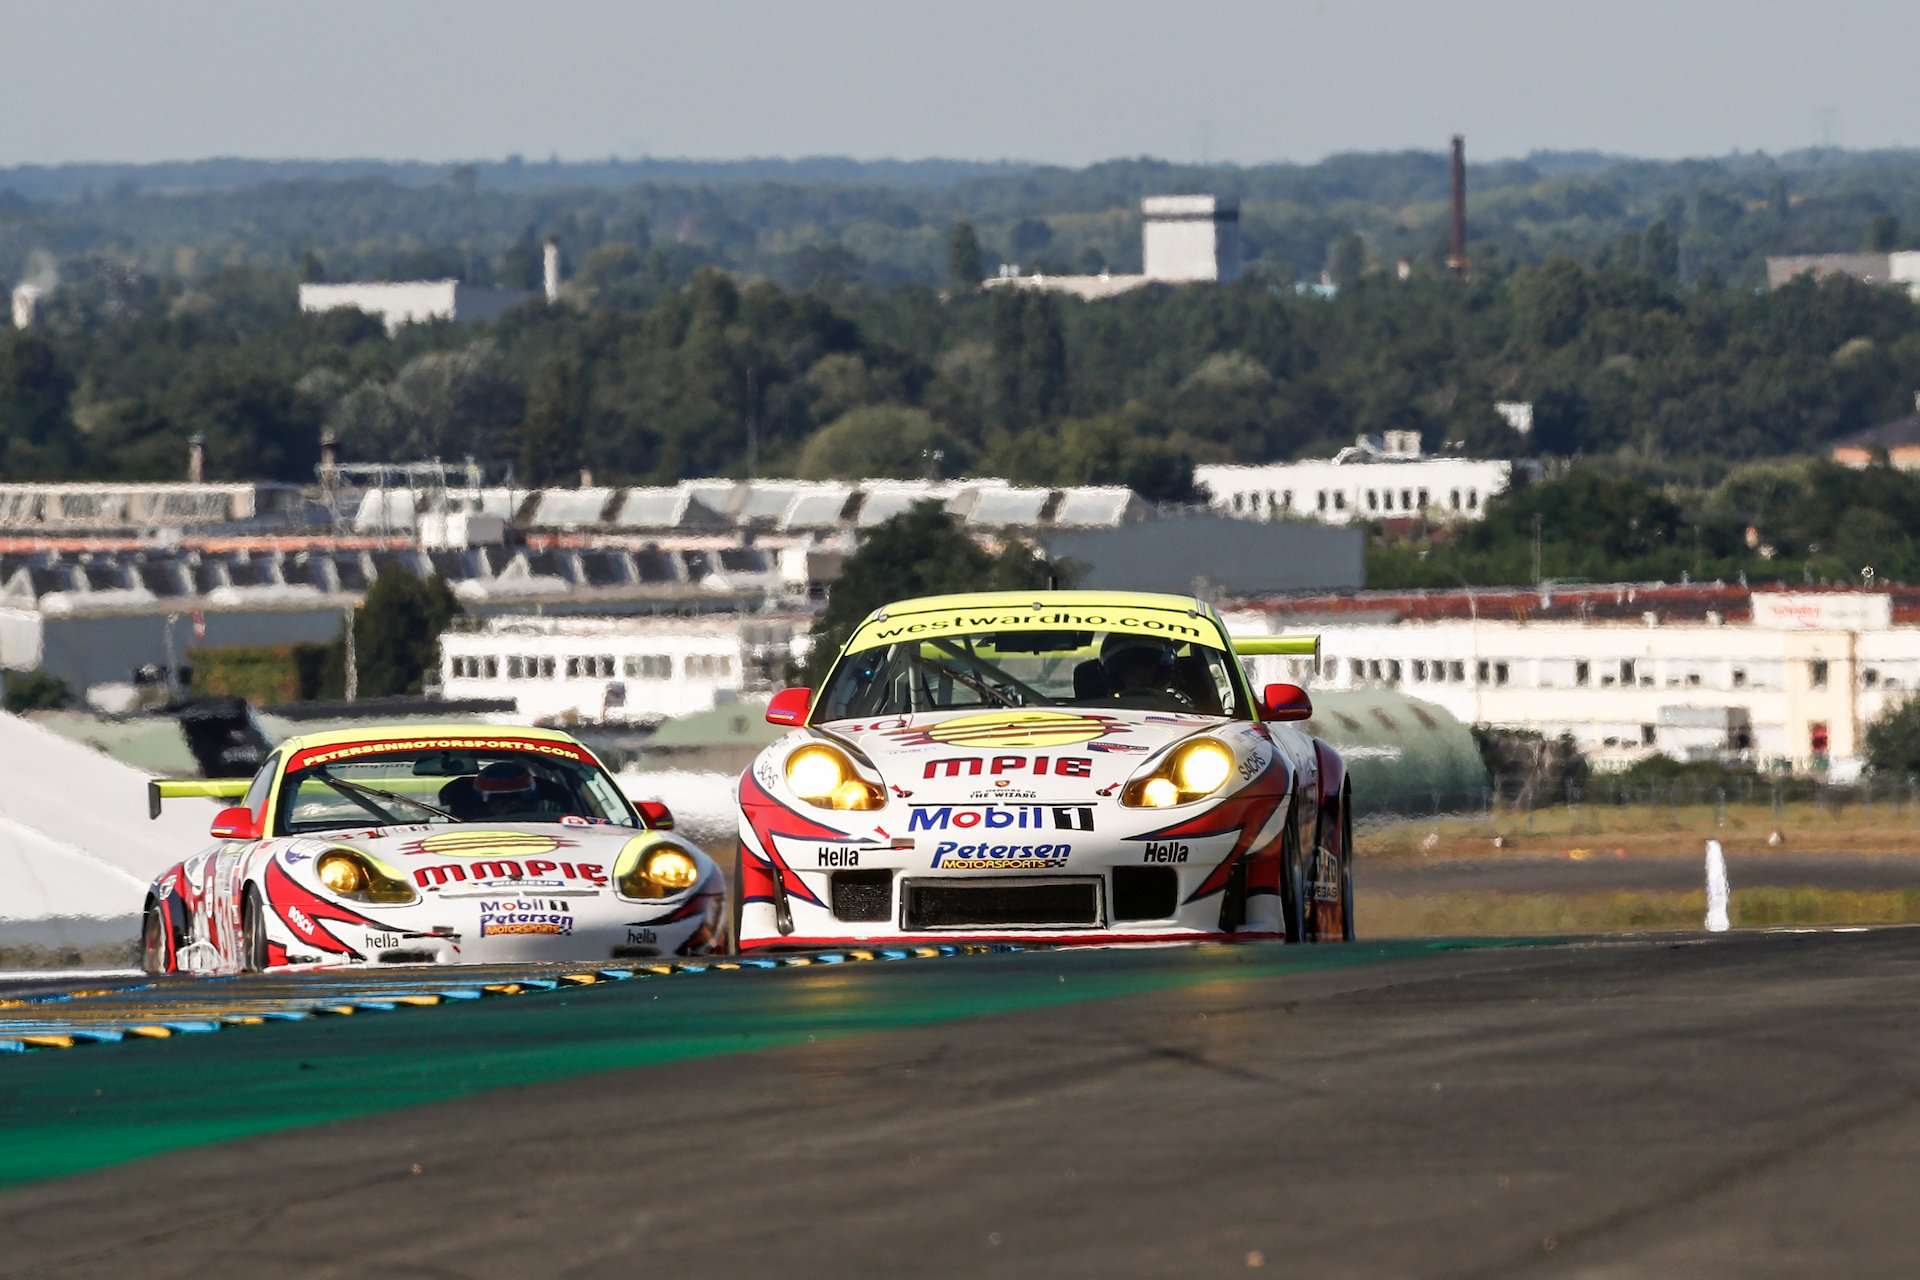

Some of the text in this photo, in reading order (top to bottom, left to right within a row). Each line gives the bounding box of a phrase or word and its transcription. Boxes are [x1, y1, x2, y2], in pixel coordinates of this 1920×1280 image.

[876, 613, 1201, 639] westwardho.com
[304, 740, 580, 767] PETERSENMOTORSPORTS.COM
[1238, 751, 1266, 781] SACHS
[908, 806, 1084, 832] Mobil 1
[818, 846, 860, 867] Hella
[930, 841, 1072, 869] Petersen
[942, 859, 1047, 869] MOTORSPORTS
[1144, 842, 1188, 864] Hella
[481, 898, 544, 912] Mobil
[288, 905, 315, 936] BOSCH
[480, 913, 574, 938] Petersen
[486, 924, 561, 935] MOTORSPORTS
[366, 933, 400, 949] hella
[627, 928, 657, 945] hella
